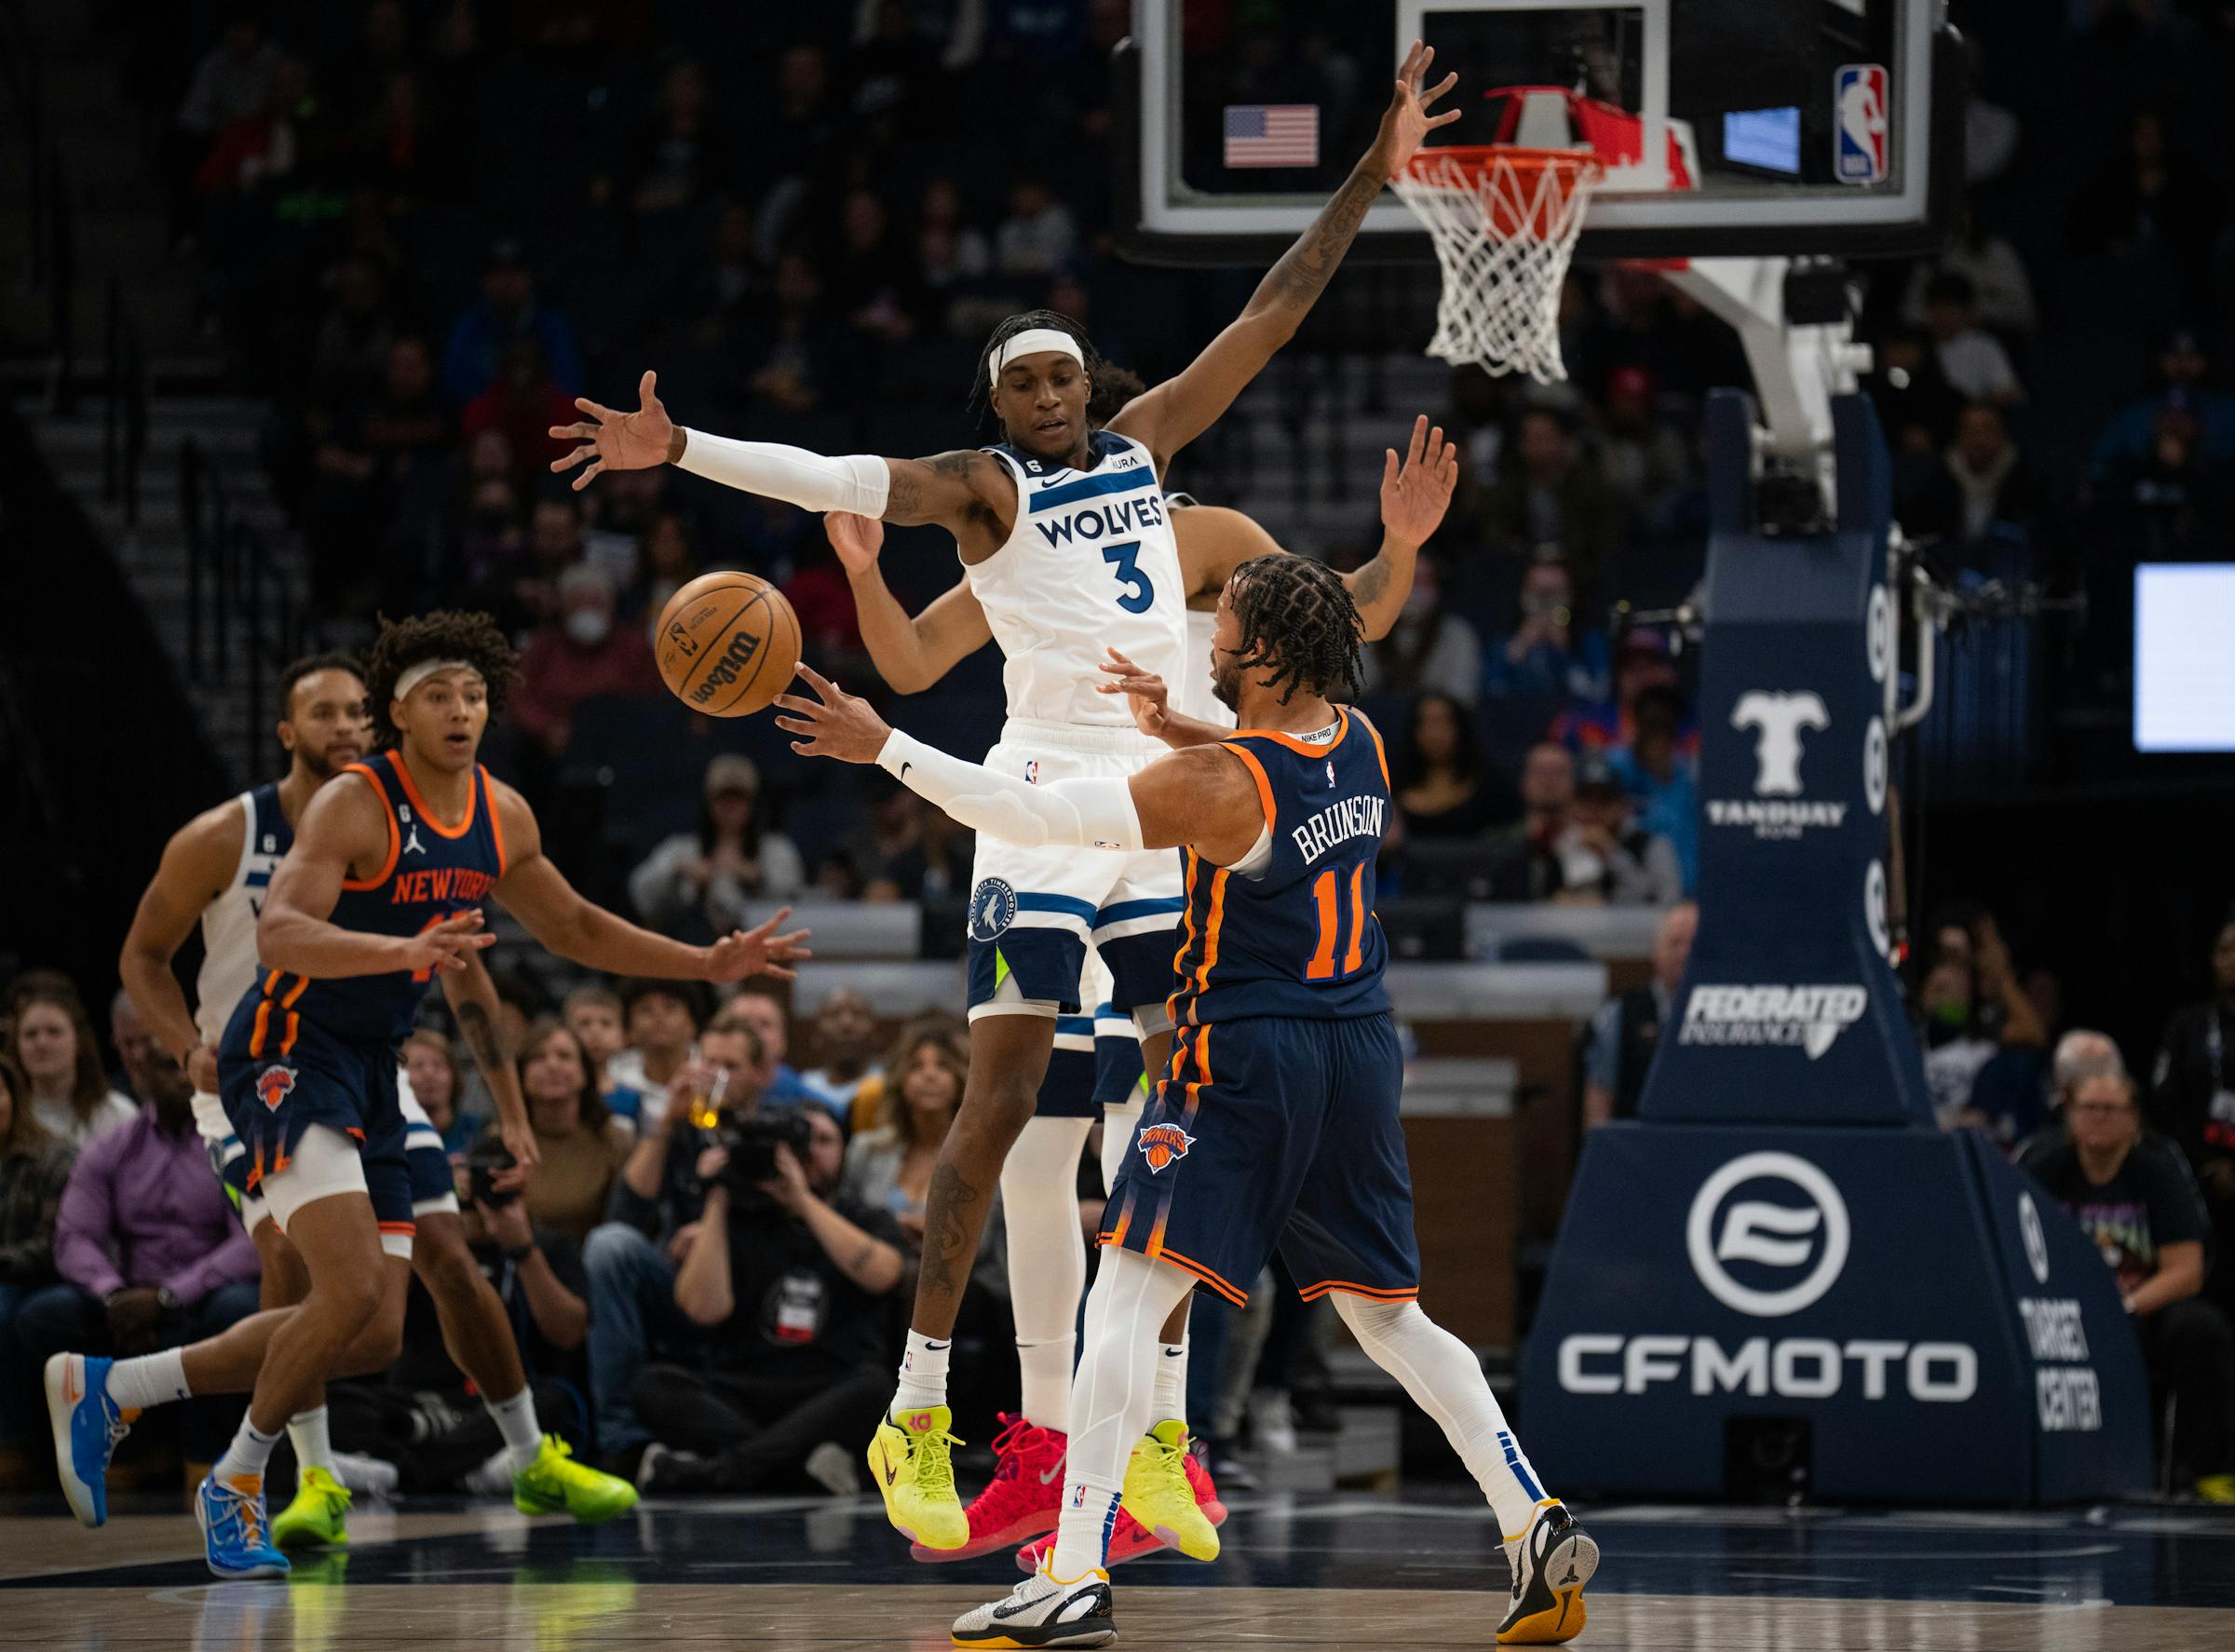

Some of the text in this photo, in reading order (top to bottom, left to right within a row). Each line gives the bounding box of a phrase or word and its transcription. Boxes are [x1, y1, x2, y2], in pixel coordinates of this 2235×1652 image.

[1035, 494, 1162, 549] WOLVES
[1101, 540, 1155, 614] 3
[689, 630, 761, 705] Wilson
[1301, 727, 1332, 743] NIKE PRO
[1292, 794, 1385, 866] BRUNSON
[392, 867, 453, 905] NEW
[1304, 858, 1366, 983] 11
[1686, 984, 1868, 1022] FEDERATED
[1140, 1127, 1186, 1154] KNICKS
[1557, 1334, 1978, 1403] CFMOTO
